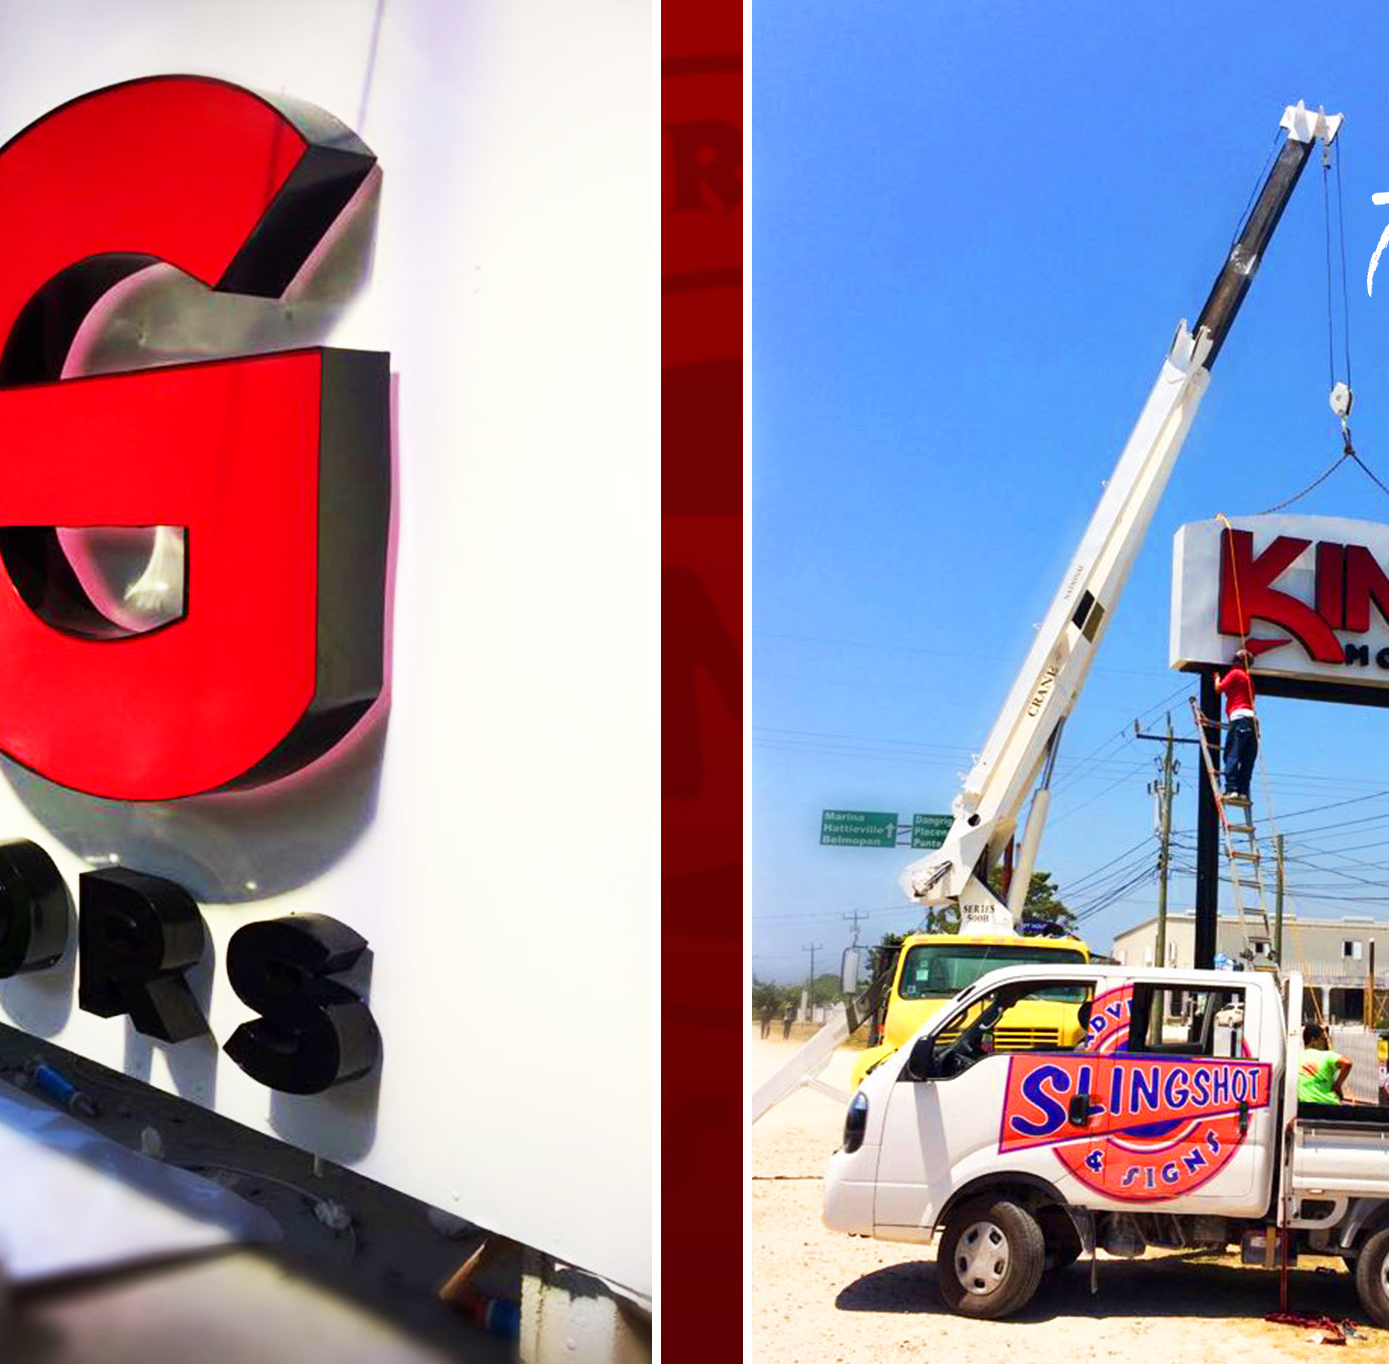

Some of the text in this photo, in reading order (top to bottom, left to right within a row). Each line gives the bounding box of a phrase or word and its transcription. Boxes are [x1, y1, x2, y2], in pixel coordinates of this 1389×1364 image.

[825, 811, 865, 822] Marina
[915, 815, 953, 827] Dangrig
[823, 823, 885, 834] Hattieville
[915, 826, 947, 837] Placen
[822, 835, 881, 846] Belmopan
[1011, 1065, 1259, 1136] SLINGSHOT
[1086, 1130, 1220, 1189] & SIGNS
